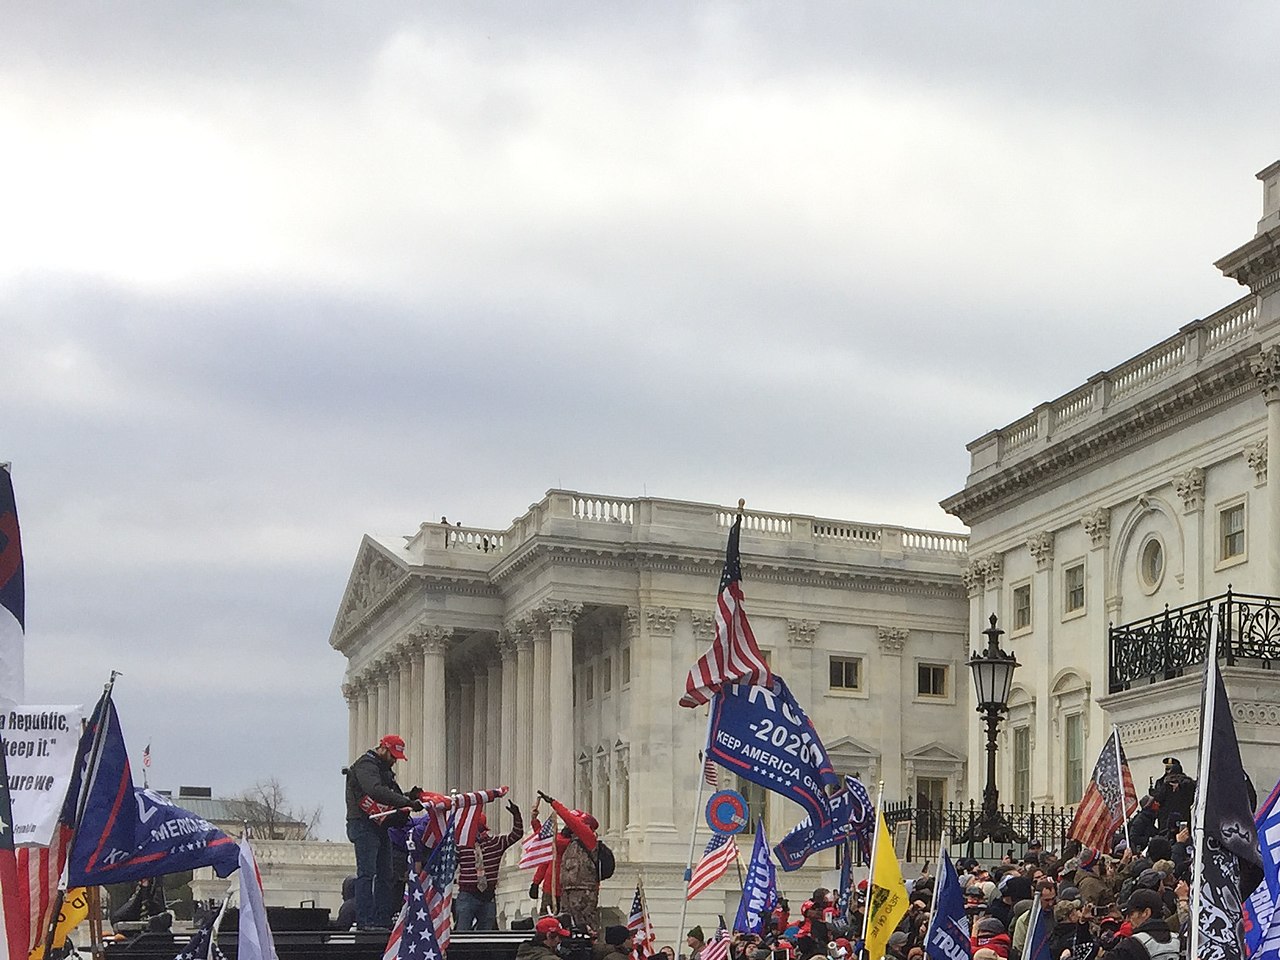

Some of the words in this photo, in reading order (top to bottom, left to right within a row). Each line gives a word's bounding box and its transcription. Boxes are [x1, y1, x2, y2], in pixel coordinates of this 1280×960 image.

[9, 711, 69, 732] Republic,
[717, 729, 742, 751] KEEP
[741, 744, 800, 780] AMERICA
[35, 775, 54, 791] we
